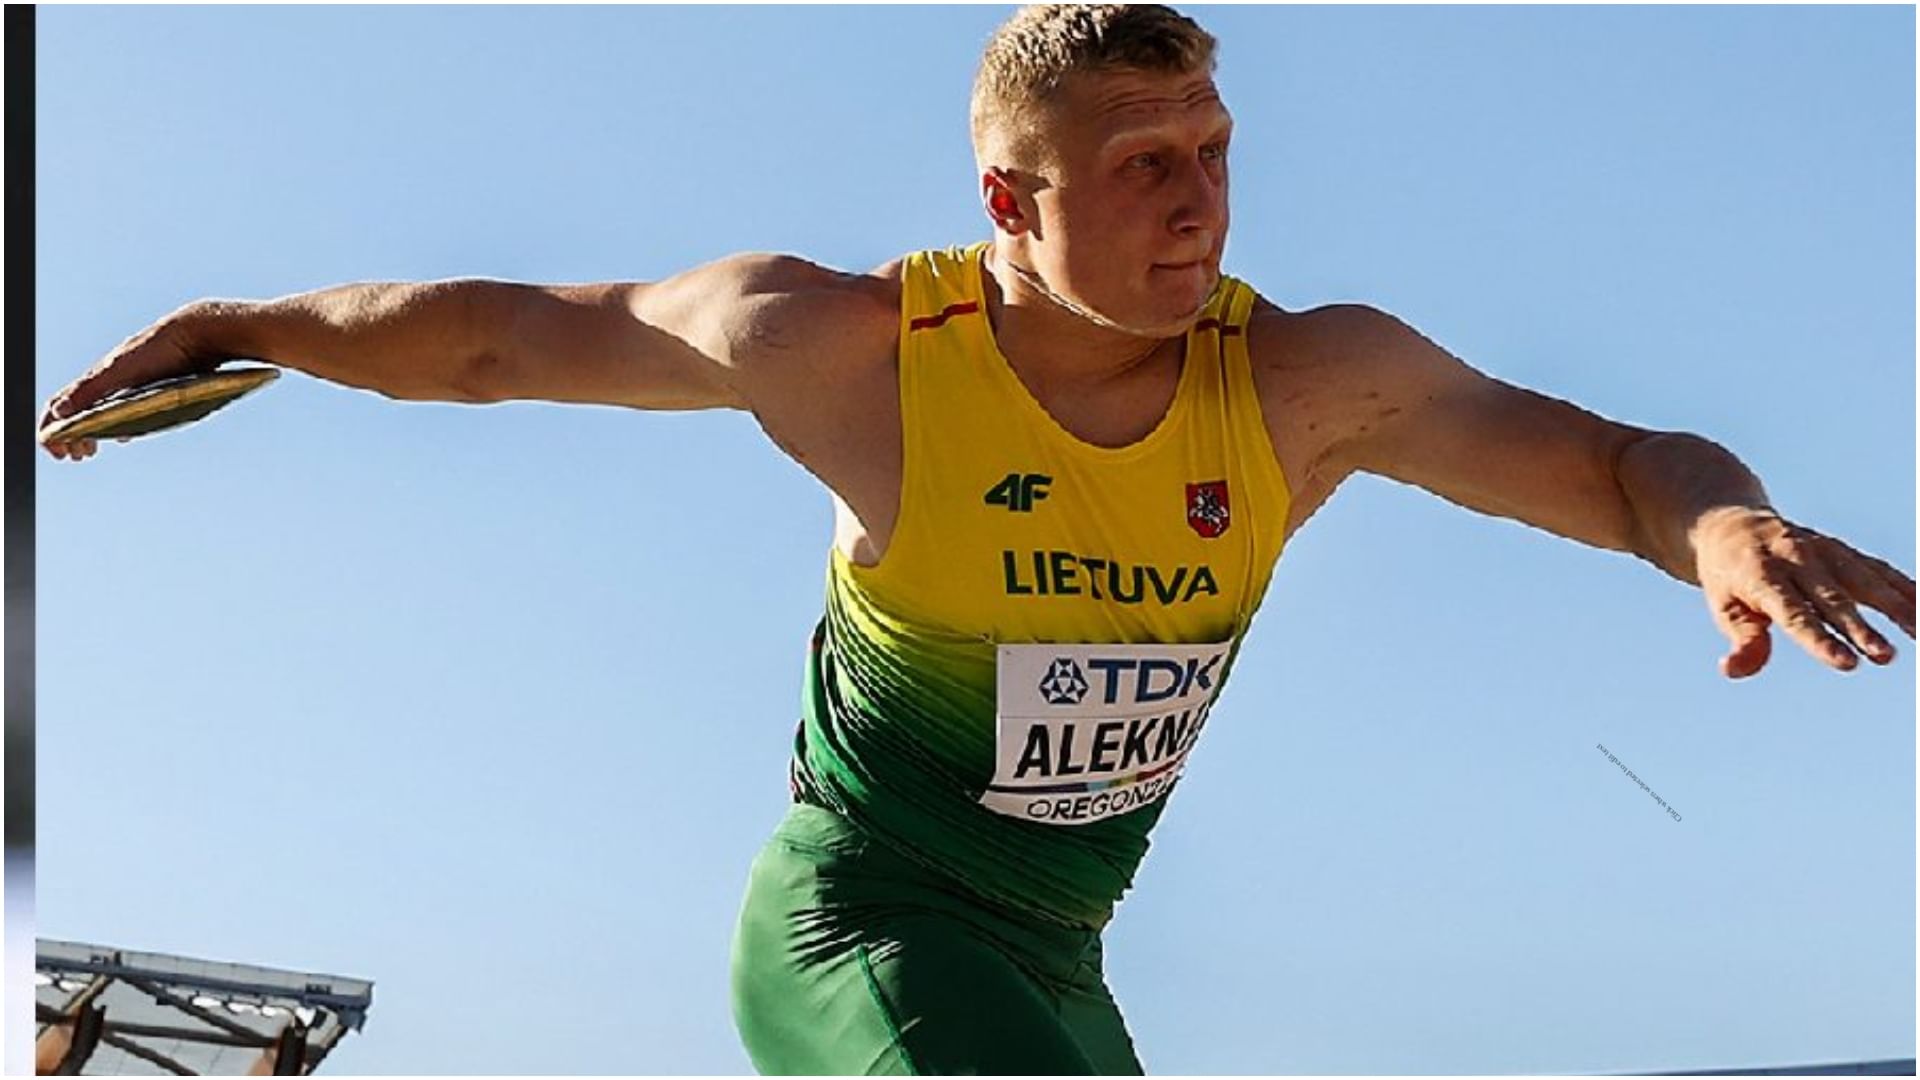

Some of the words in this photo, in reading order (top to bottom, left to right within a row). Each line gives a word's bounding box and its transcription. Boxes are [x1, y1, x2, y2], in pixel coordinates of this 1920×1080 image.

[984, 474, 1053, 512] 4F
[1004, 551, 1219, 606] LIETUVA
[1088, 654, 1222, 704] TDK
